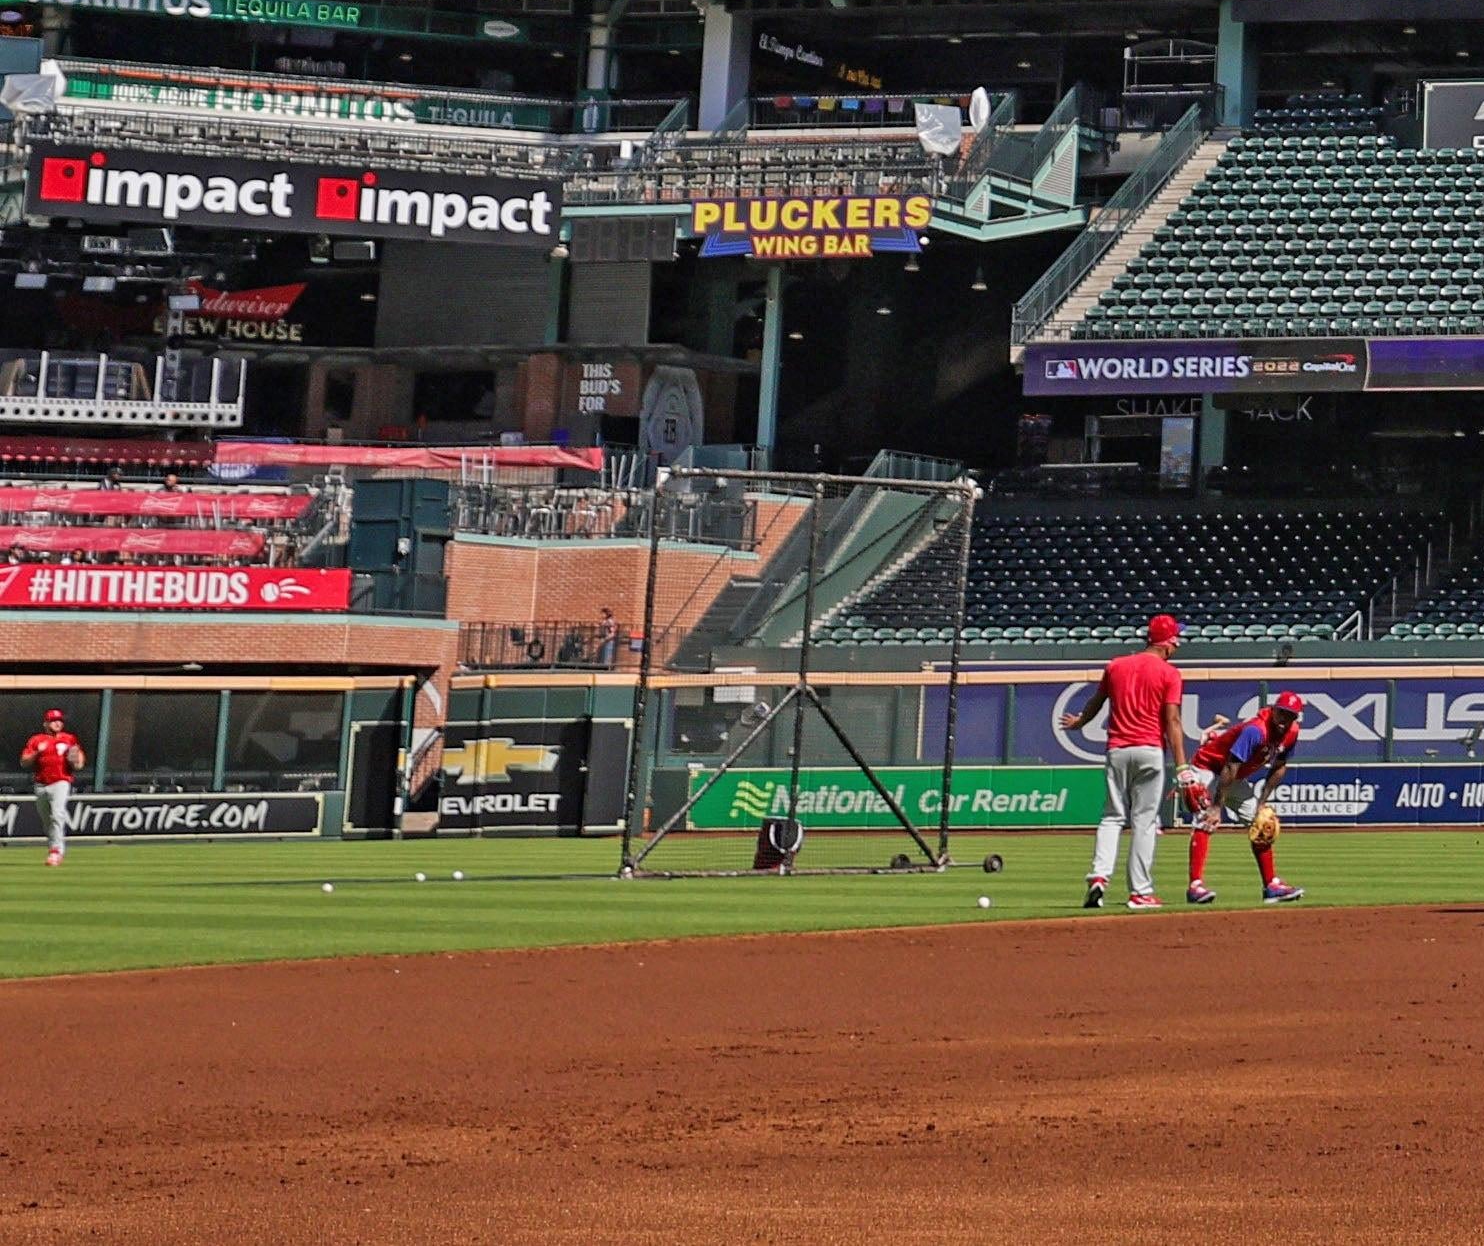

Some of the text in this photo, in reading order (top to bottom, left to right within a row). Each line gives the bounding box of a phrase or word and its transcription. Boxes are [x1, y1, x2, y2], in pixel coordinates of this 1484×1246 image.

[317, 5, 362, 23] BAR
[214, 86, 415, 124] HORNITOS
[428, 106, 516, 129] TEQUILA
[86, 152, 295, 217] impact
[358, 171, 552, 237] impact
[693, 195, 932, 233] PLUCKERS
[751, 233, 871, 256] WING BAR
[227, 319, 303, 342] HOUSE
[582, 363, 614, 378] THIS
[1078, 358, 1165, 379] WORLD
[1172, 356, 1250, 378] SERIES
[1253, 361, 1300, 372] 2022
[580, 379, 622, 394] BUD'S
[578, 395, 605, 411] FOR
[29, 568, 249, 605] #HITTHEBUDS
[395, 792, 561, 816] EVROLET
[771, 781, 1067, 815] National Car Rental
[1397, 781, 1445, 808] AUTO
[1270, 803, 1355, 815] NSURANCE
